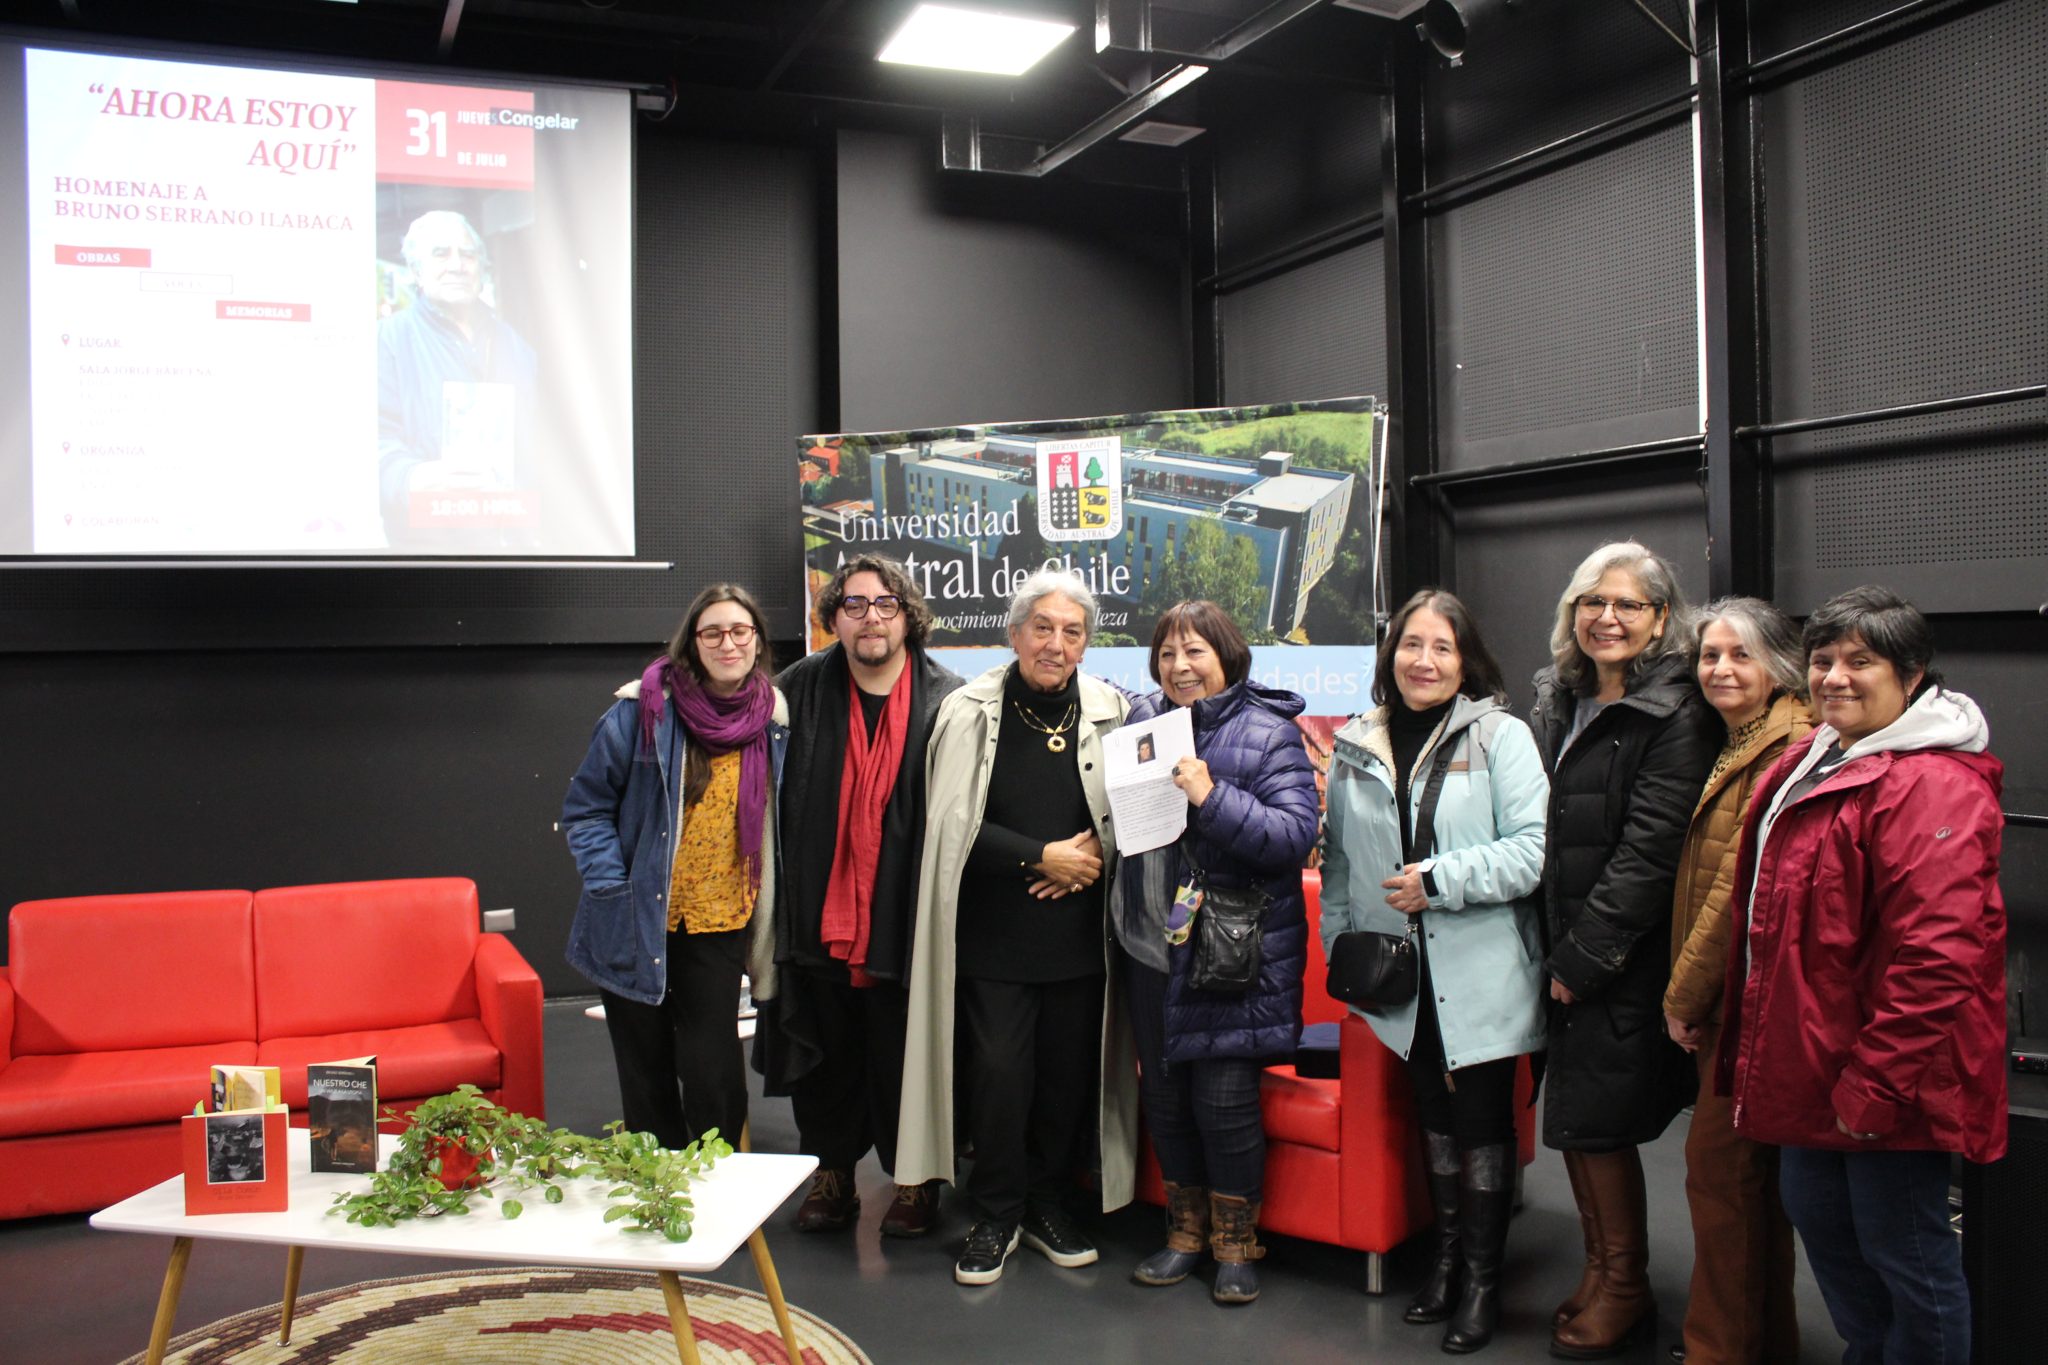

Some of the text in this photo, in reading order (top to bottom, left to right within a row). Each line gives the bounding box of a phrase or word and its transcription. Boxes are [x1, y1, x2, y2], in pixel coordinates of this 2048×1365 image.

[243, 98, 357, 132] ESTOY
[457, 110, 497, 125] JUEVES
[499, 109, 579, 130] Congelar
[406, 108, 447, 158] 31
[457, 151, 507, 168] DE JULIO
[53, 176, 208, 201] HOMENAJE A
[54, 200, 354, 231] BRUNO SERRANO ILABACA
[76, 252, 121, 264] OBRAS
[225, 305, 293, 319] MEMORIAS
[79, 337, 122, 348] LUGAR
[79, 364, 110, 375] SALA
[1046, 443, 1078, 452] LIBERTAS
[839, 498, 1021, 543] Universidad
[1072, 529, 1106, 539] AUSTRAL
[836, 540, 985, 599] tral
[992, 555, 1029, 598] de
[931, 609, 1009, 629] nocimient
[313, 1078, 368, 1089] NUESTRO CHE
